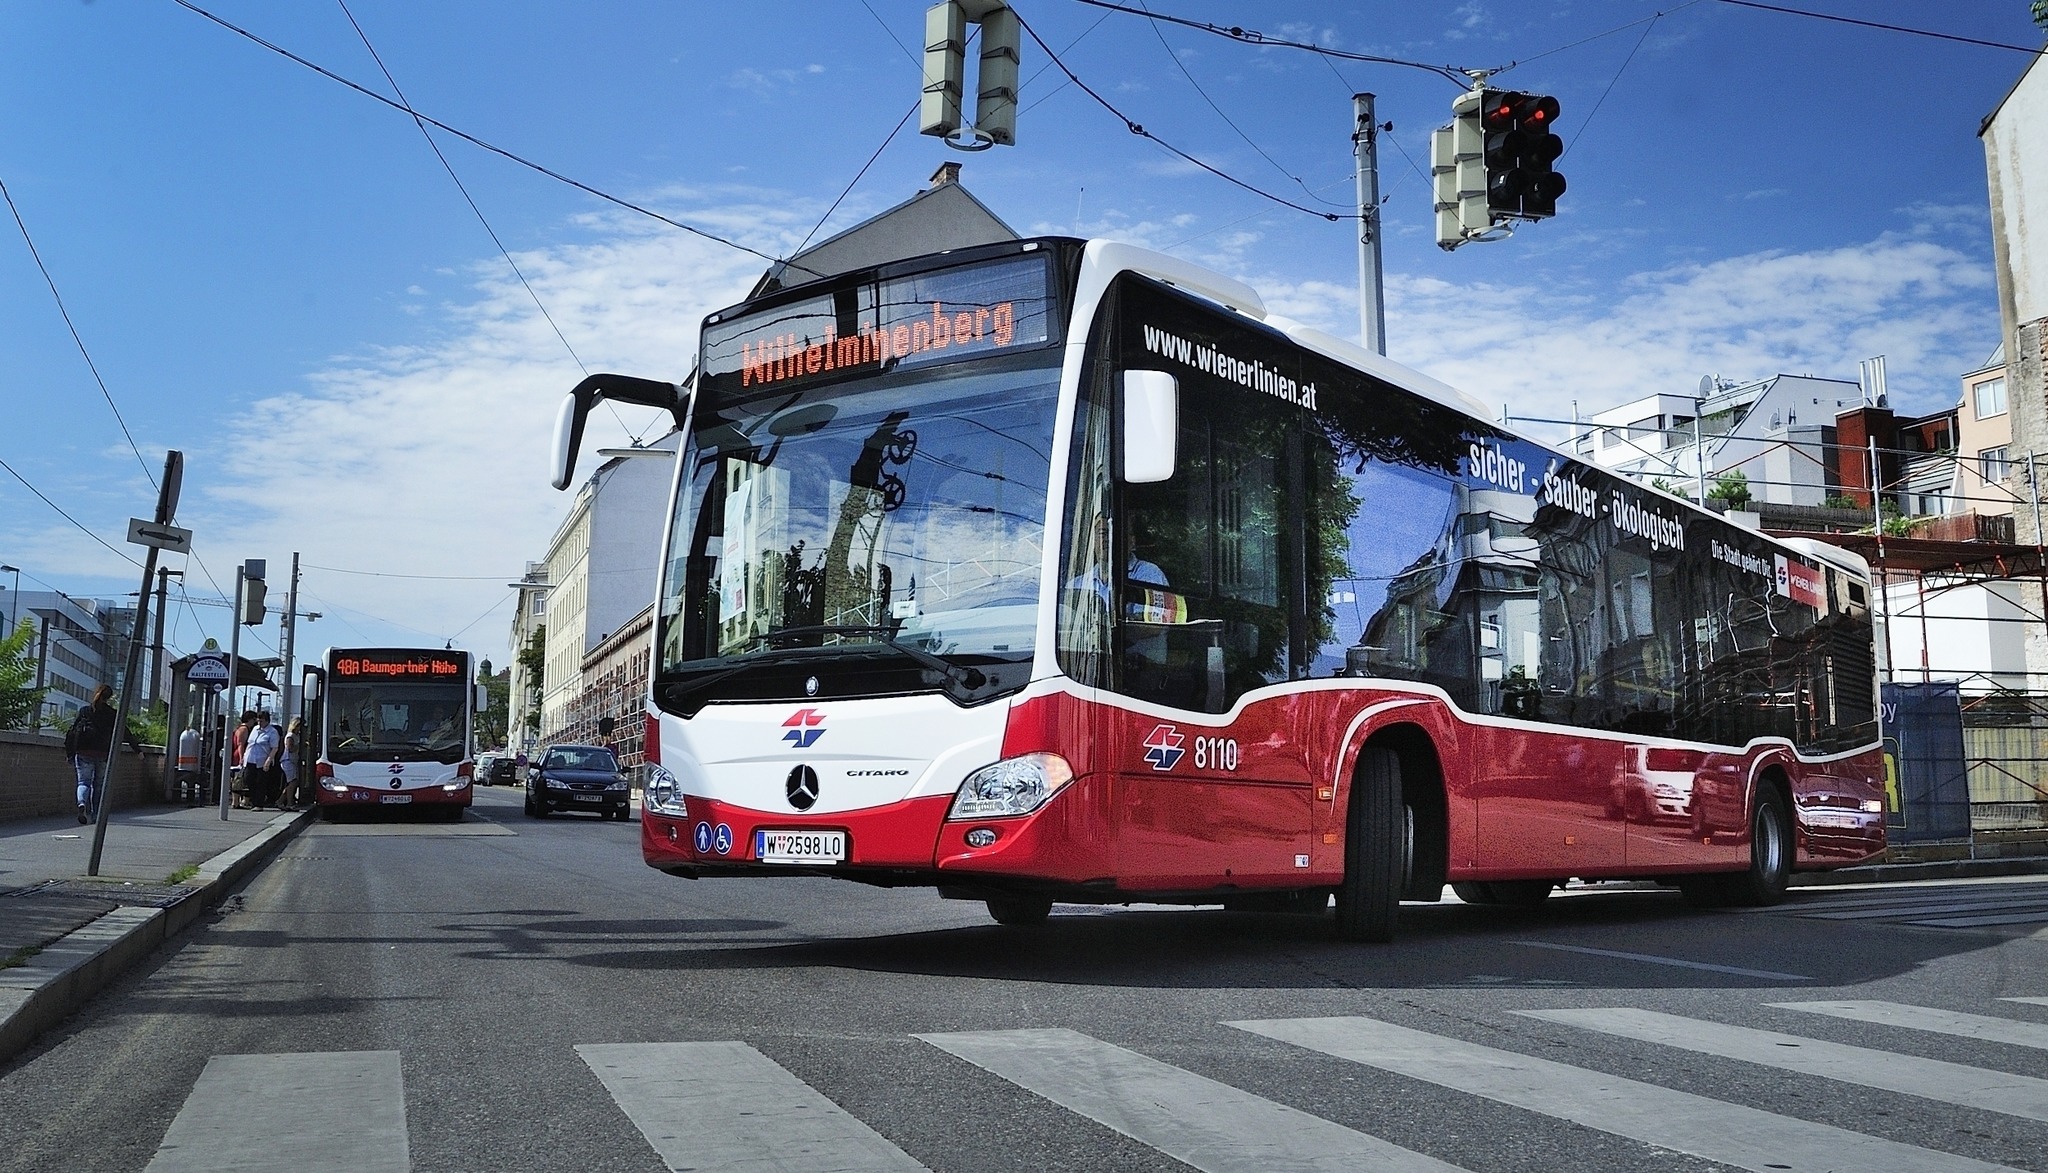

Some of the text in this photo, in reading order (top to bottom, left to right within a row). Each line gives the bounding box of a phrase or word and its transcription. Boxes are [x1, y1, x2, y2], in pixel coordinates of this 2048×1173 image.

[742, 300, 1013, 387] Wilhelminenberg
[1143, 323, 1318, 411] www.wienerlinien.at
[1469, 436, 1685, 552] sicher - sauber - ökologisch
[1711, 538, 1724, 561] Die
[1723, 543, 1742, 568] Stadt
[1741, 552, 1762, 574] gehört
[197, 660, 223, 669] AUTOBUS
[337, 659, 457, 675] 48A Baumgartner Höhe
[1194, 736, 1238, 771] 8110
[846, 769, 909, 777] CITARO
[767, 836, 840, 855] W 2598 LO
